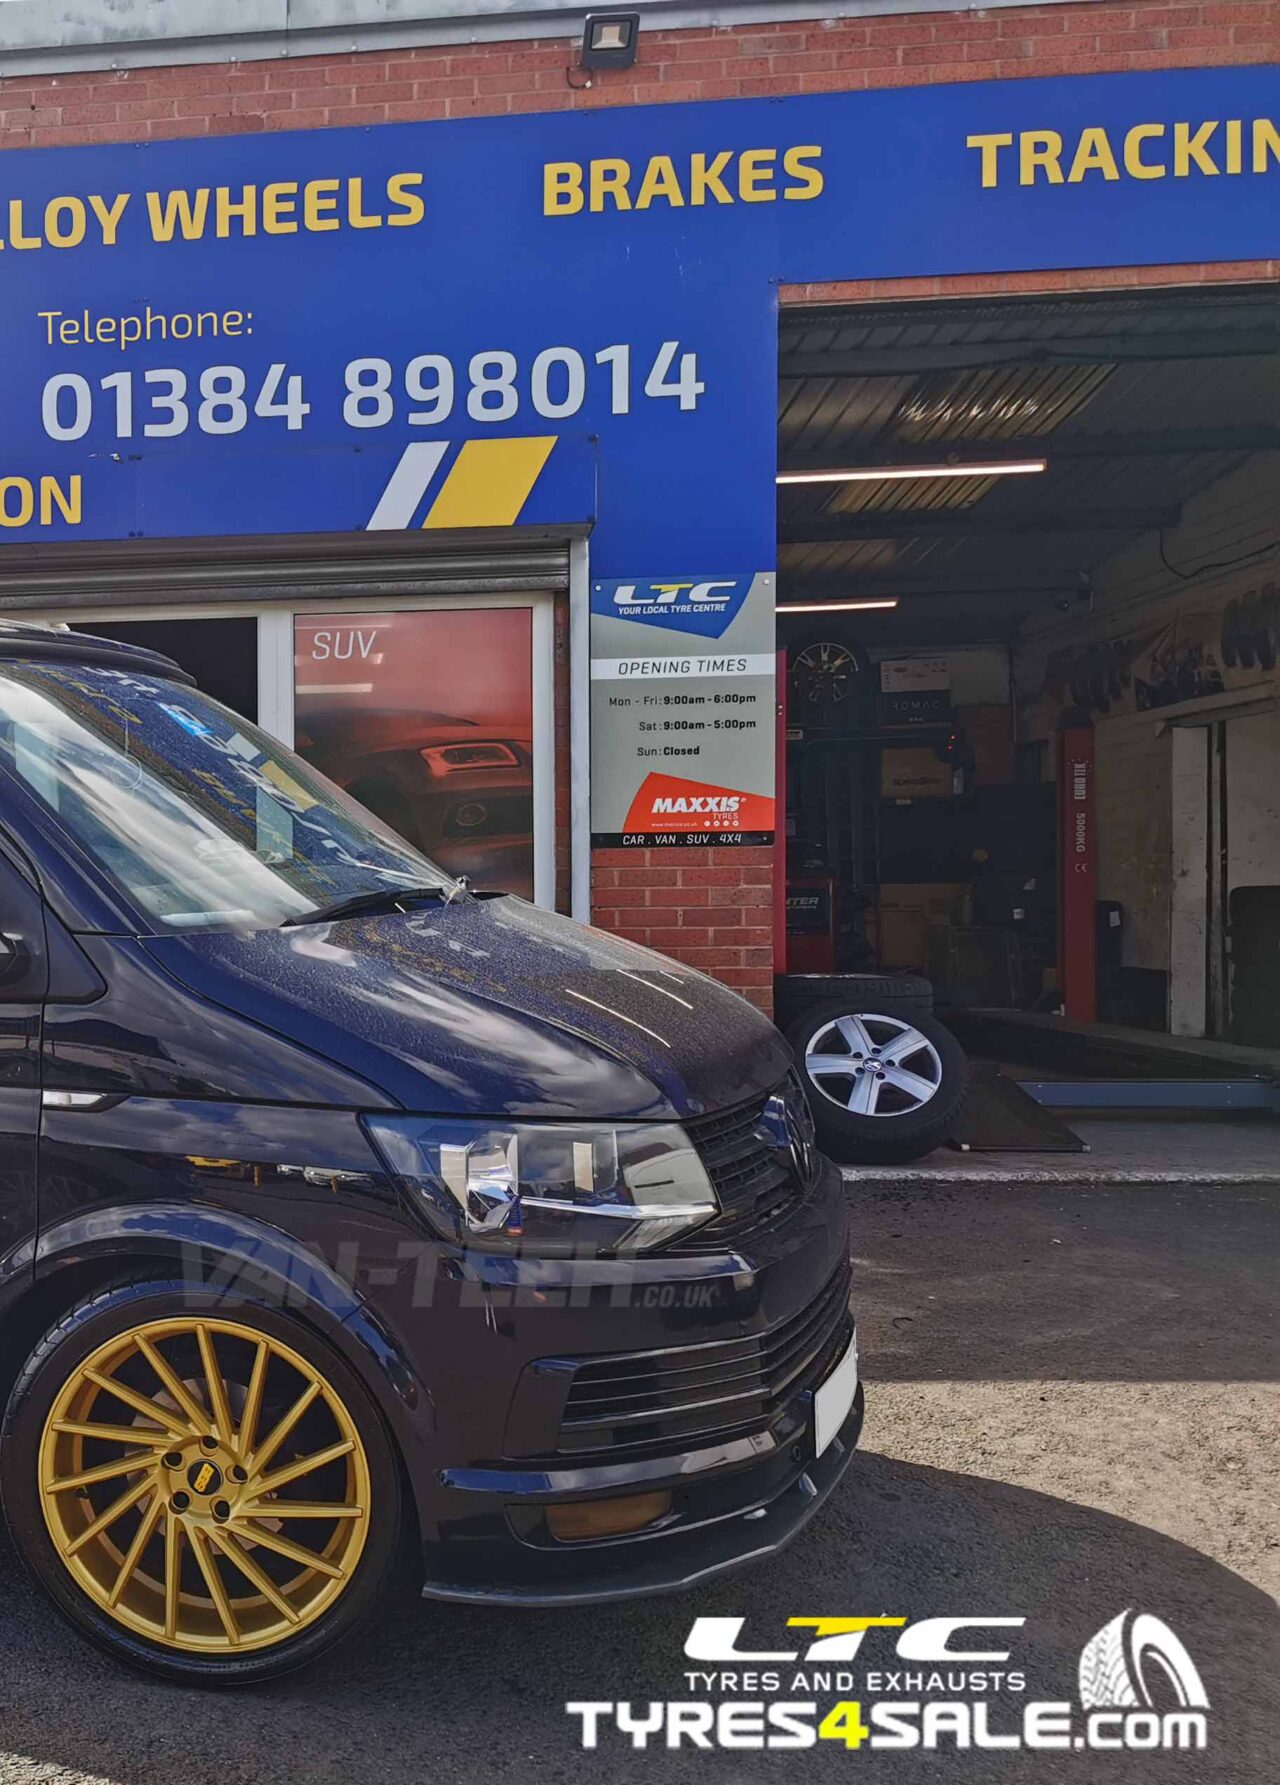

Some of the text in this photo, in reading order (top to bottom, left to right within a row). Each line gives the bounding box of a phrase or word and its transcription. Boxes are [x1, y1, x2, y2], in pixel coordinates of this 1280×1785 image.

[543, 145, 824, 216] BRAKES
[146, 173, 424, 242] WHEELS
[38, 308, 253, 350] Telephone:
[42, 341, 704, 441] 01384 898014
[613, 581, 736, 604] LTC
[619, 603, 726, 615] YOUR LOCAL TYRE CENTRE
[312, 631, 376, 660] SUV
[618, 658, 747, 675] OPENING TIMES
[609, 697, 631, 706] Mon
[663, 746, 700, 756] Closed
[713, 812, 739, 820] TYRES
[623, 834, 645, 845] CAR
[655, 834, 677, 844] VAN
[686, 833, 710, 844] SUV
[719, 833, 742, 844] 4X4
